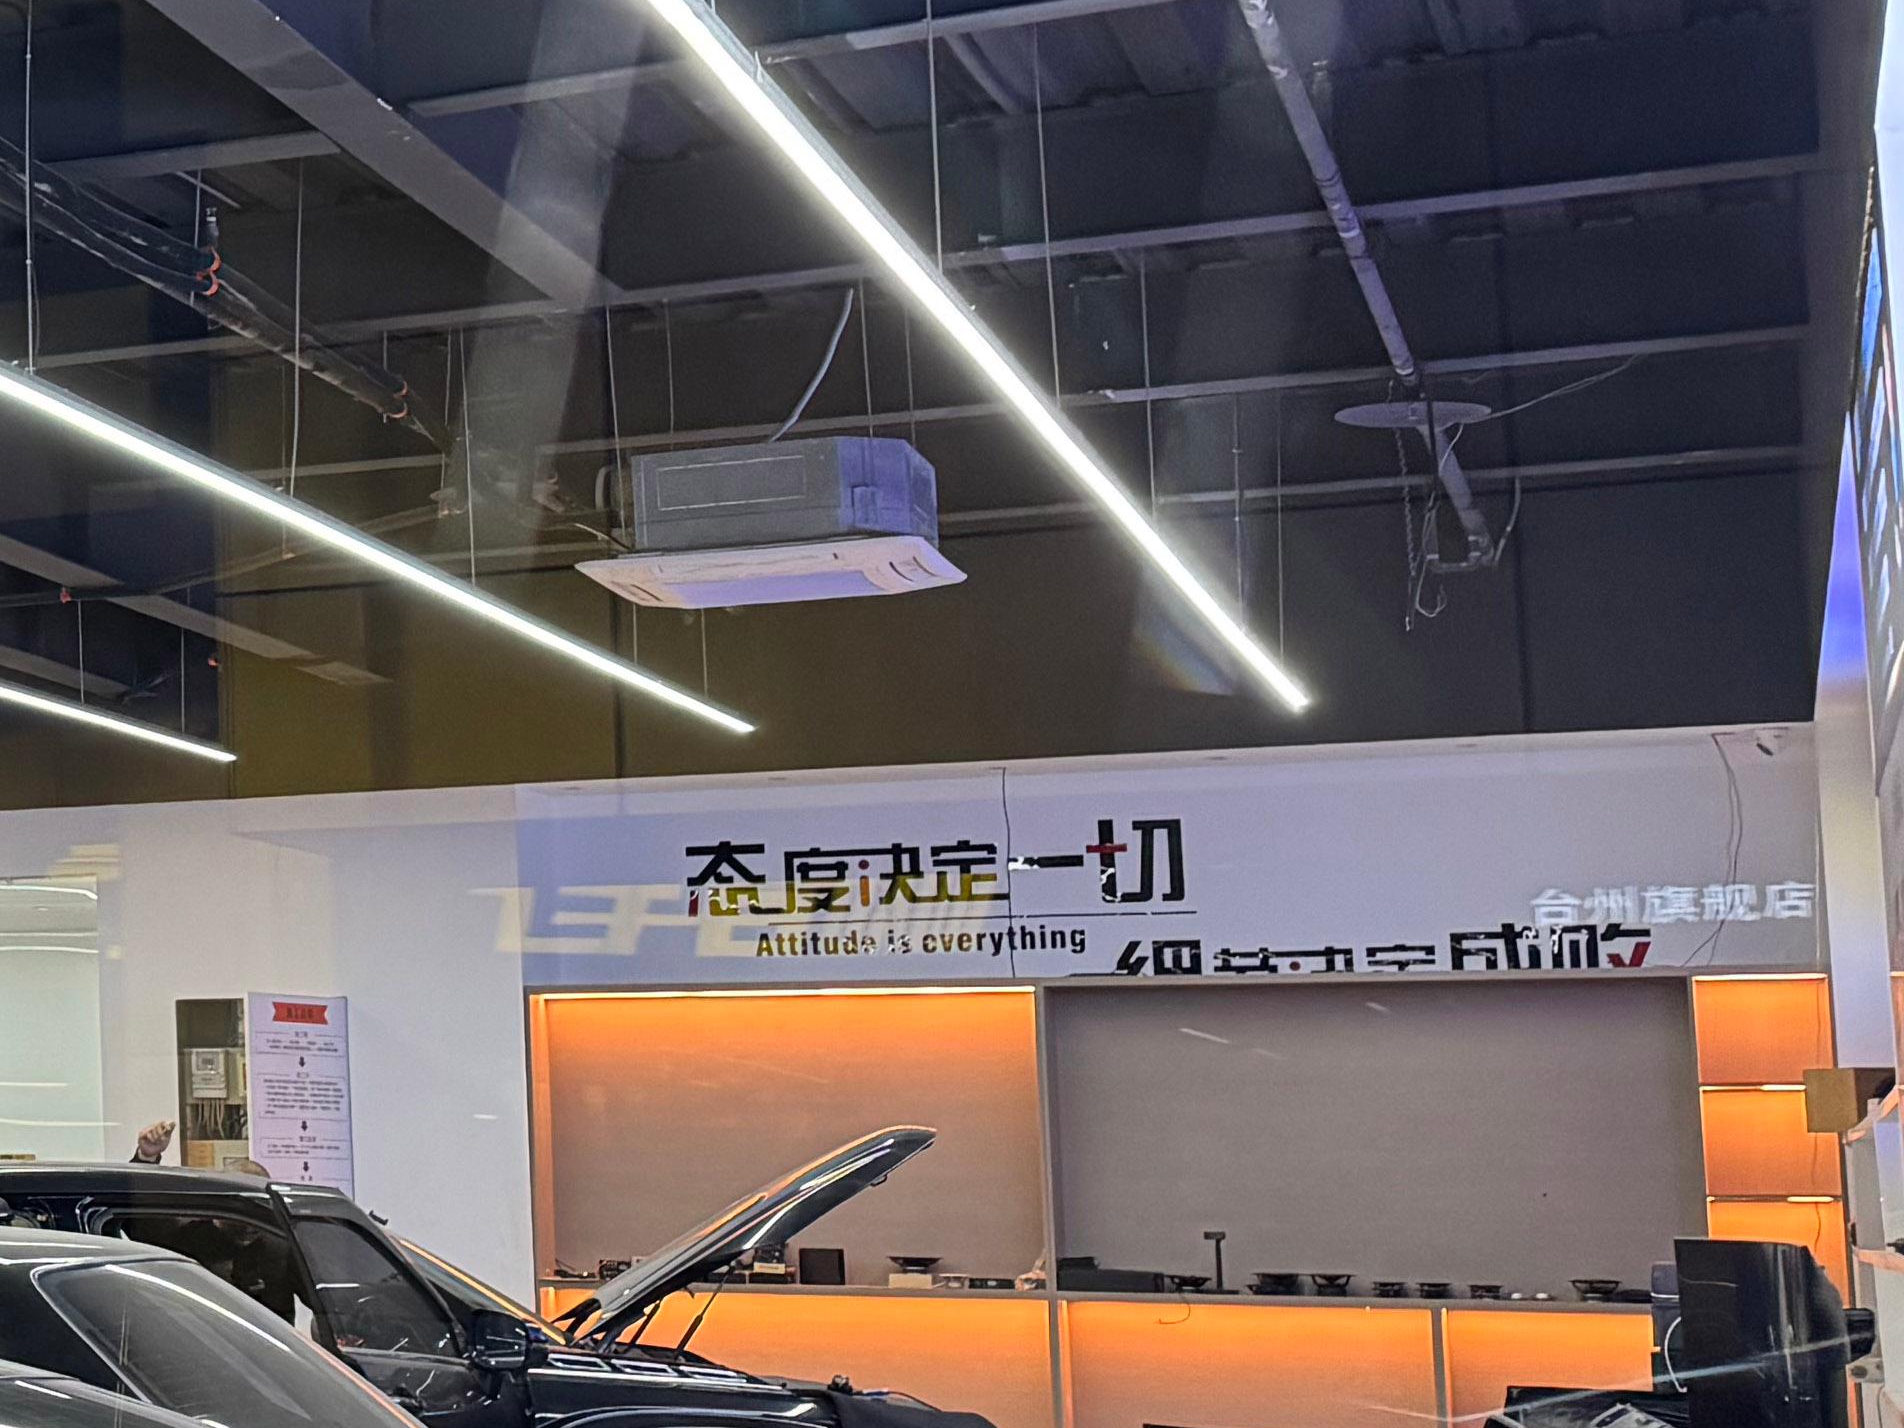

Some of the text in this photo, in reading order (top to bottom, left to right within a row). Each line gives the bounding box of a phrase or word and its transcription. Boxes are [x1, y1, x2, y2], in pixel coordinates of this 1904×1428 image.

[686, 819, 1185, 917] 态度决定一切
[756, 923, 1086, 958] Attitude is everything
